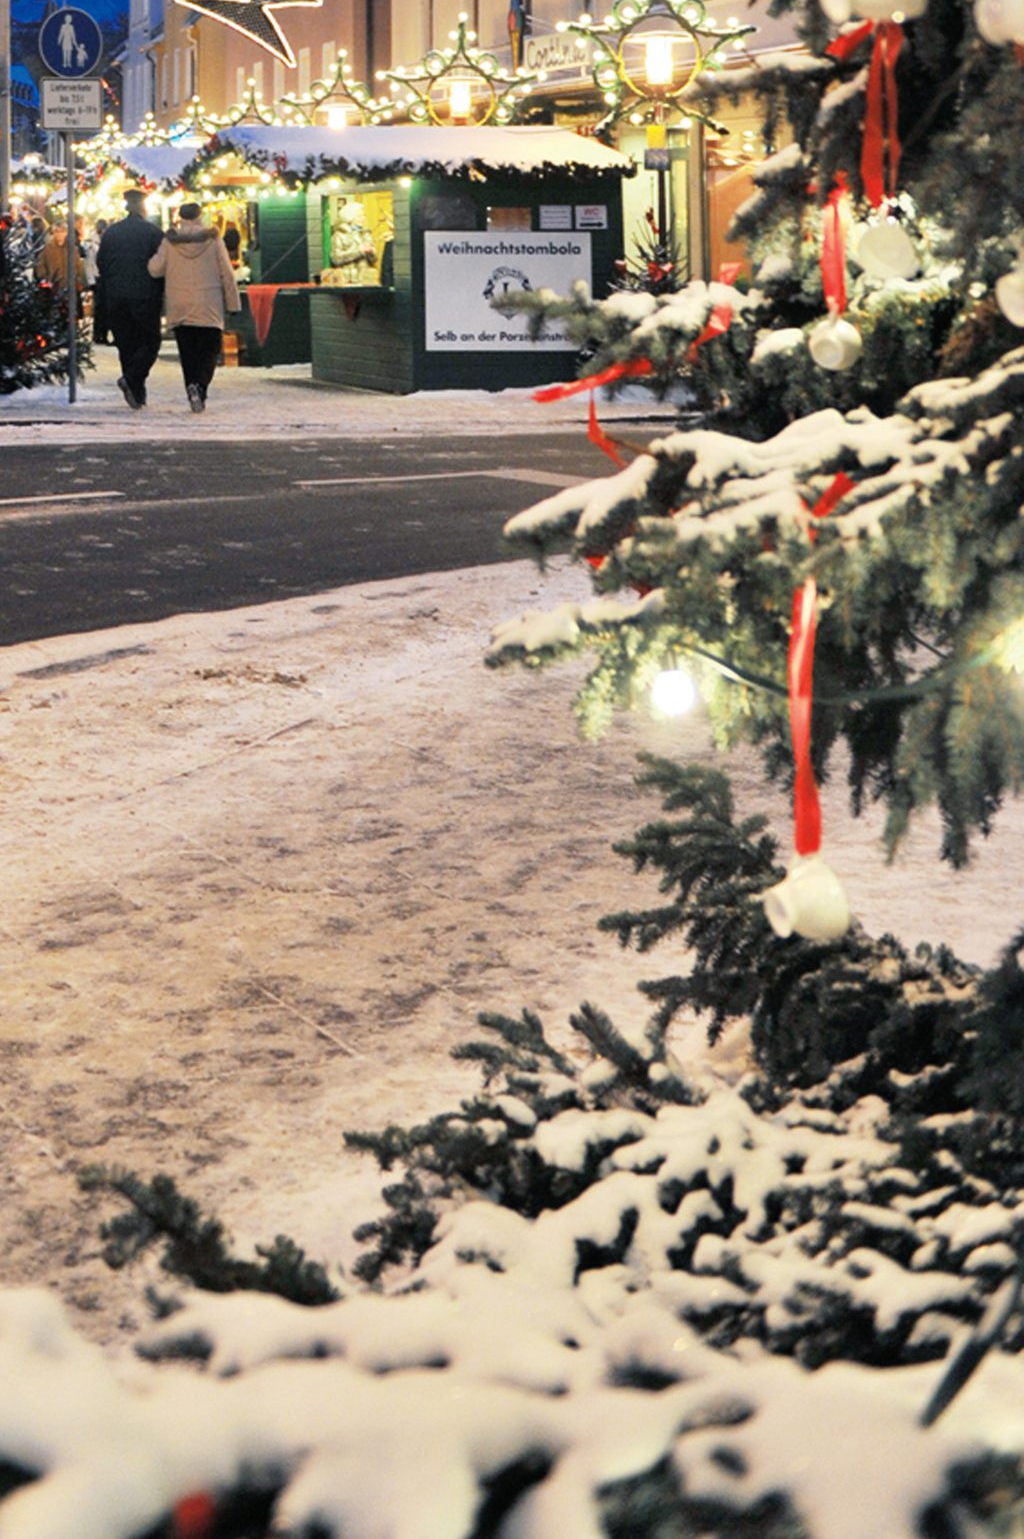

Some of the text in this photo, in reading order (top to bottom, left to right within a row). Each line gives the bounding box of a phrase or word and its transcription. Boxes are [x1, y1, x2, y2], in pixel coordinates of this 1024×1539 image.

[50, 83, 92, 92] Lieferverkehr
[47, 106, 76, 116] werktags
[437, 241, 582, 255] Weihnachtstombola
[433, 330, 458, 342] Selb
[460, 333, 475, 342] an
[478, 330, 496, 342] der
